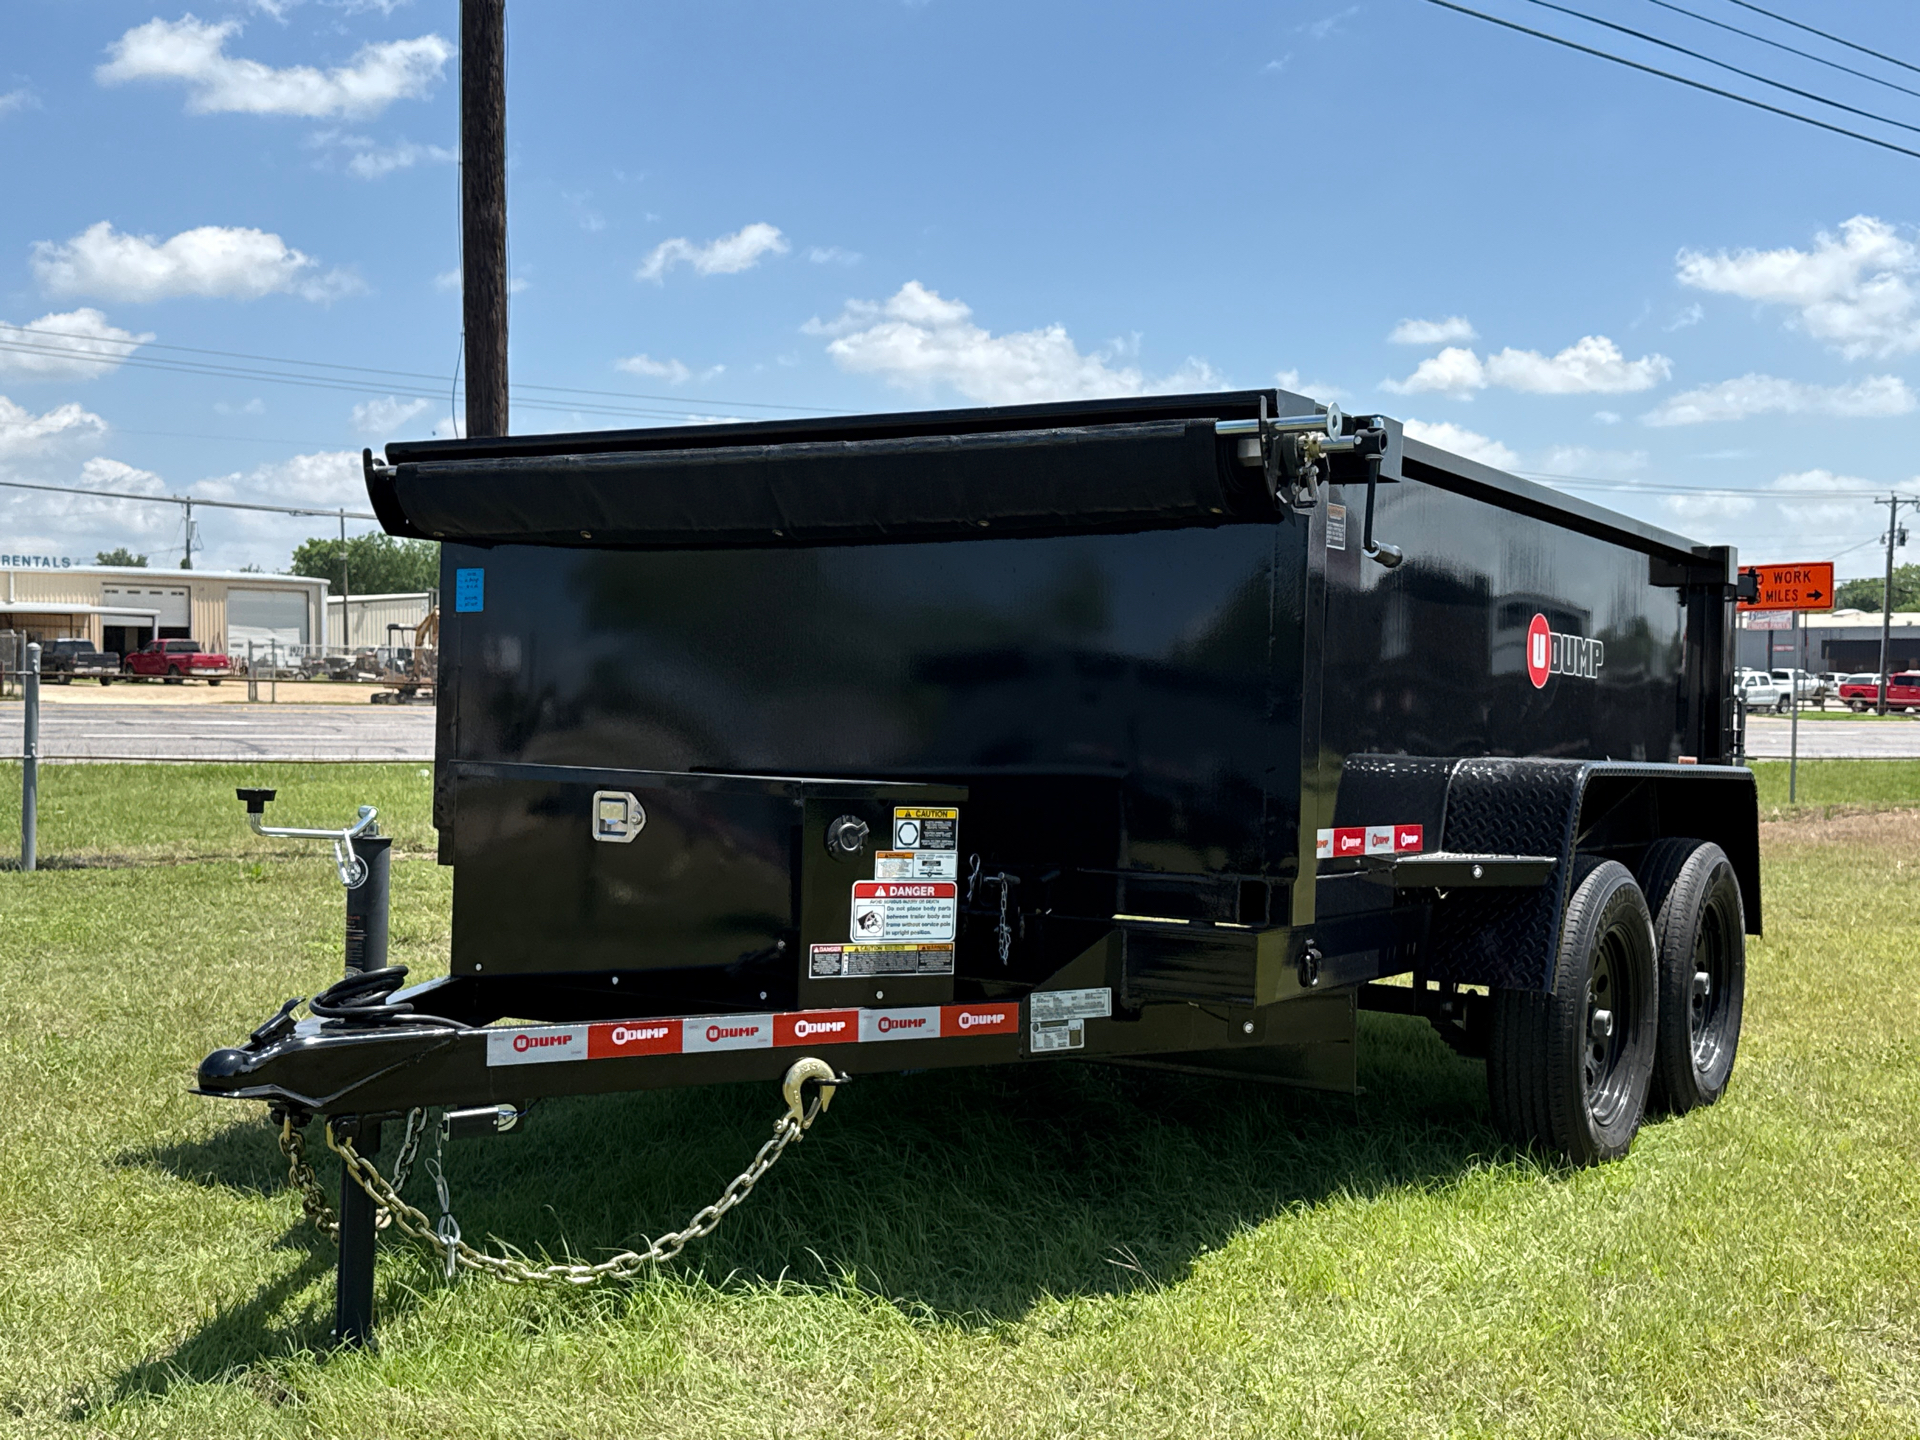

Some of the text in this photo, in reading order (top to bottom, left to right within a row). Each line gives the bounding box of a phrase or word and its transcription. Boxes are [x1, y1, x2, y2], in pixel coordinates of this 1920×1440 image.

[1, 554, 71, 568] RENTALS
[1773, 570, 1811, 584] WORK
[1766, 588, 1799, 602] MILES
[916, 810, 948, 818] CAUTION
[889, 886, 935, 896] DANGER
